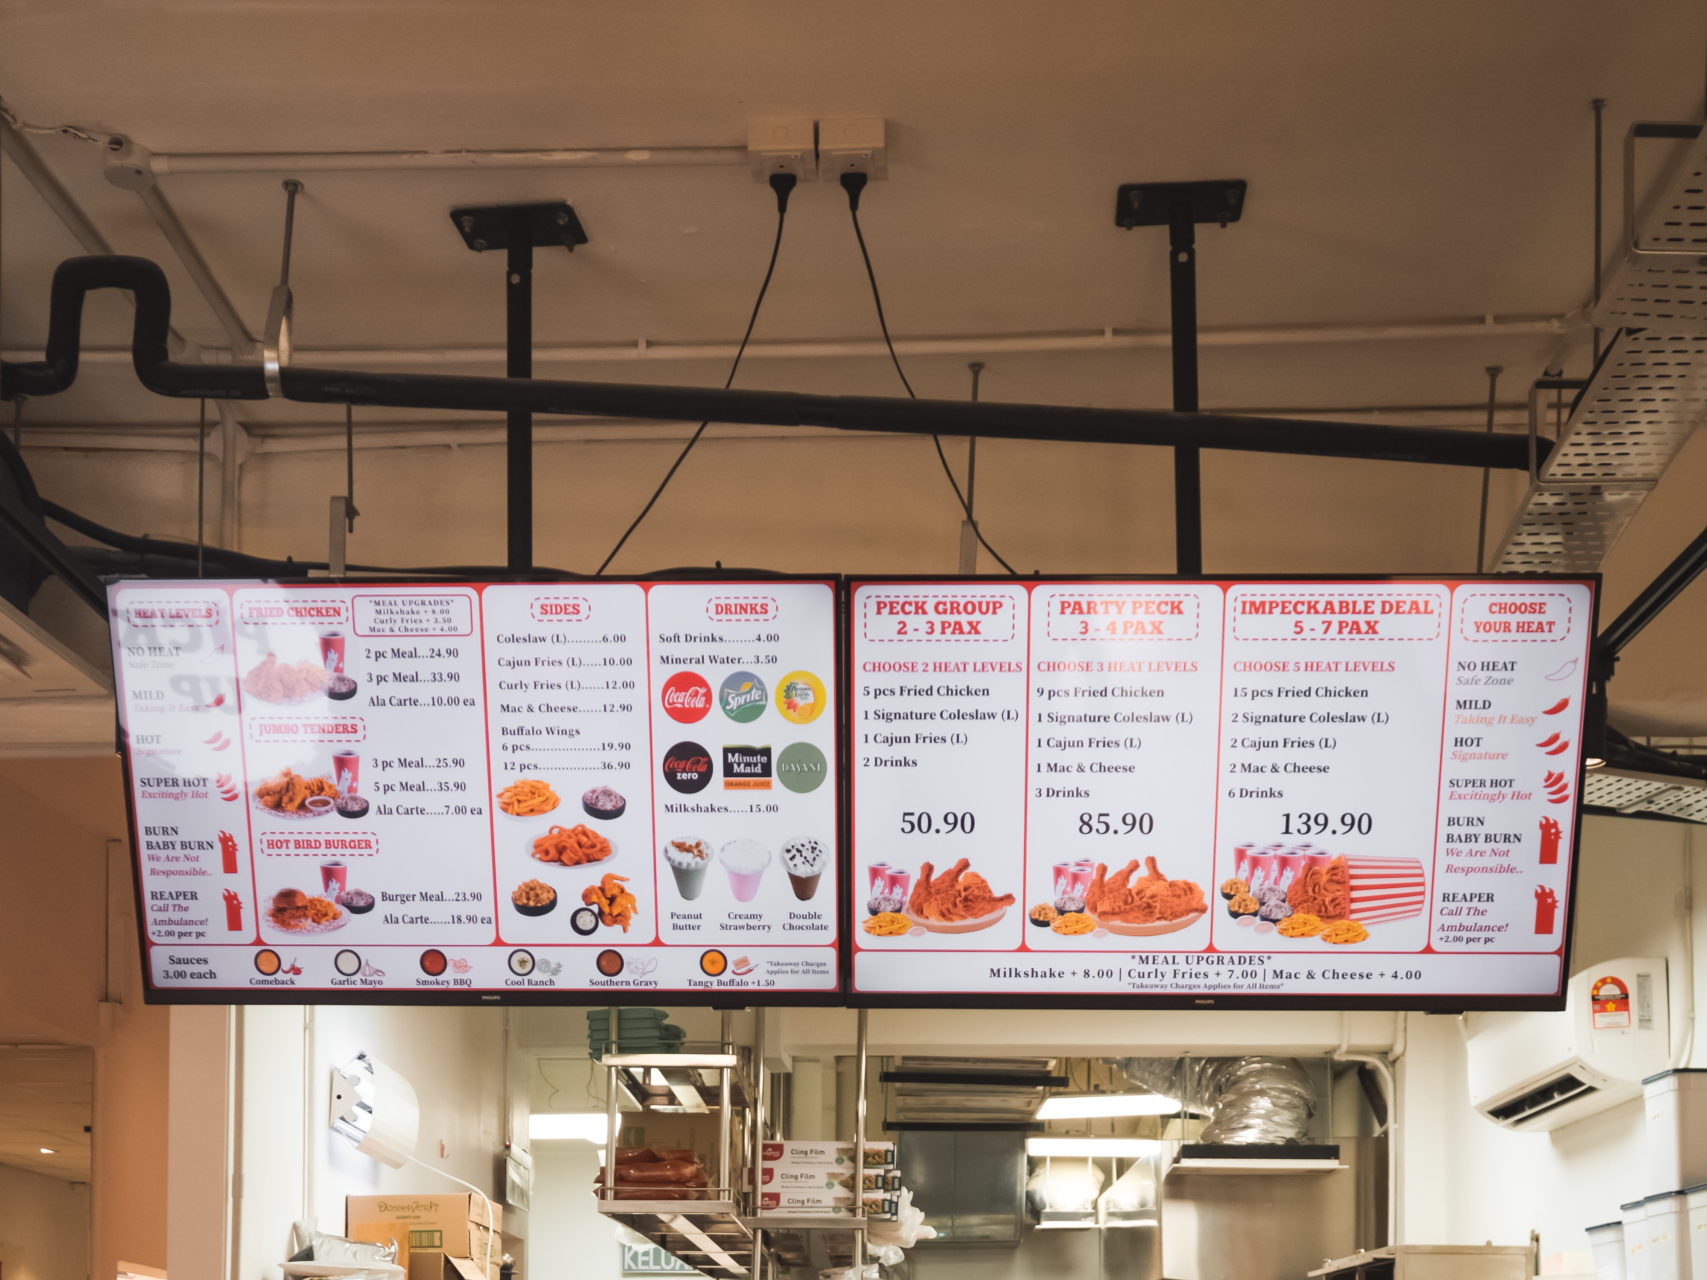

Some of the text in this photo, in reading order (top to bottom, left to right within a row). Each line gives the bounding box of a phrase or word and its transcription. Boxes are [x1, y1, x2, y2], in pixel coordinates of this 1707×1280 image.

[249, 606, 341, 618] FRIED CHICKEN
[540, 604, 580, 615] SIDES
[715, 603, 768, 615] DRINKS
[876, 601, 1003, 615] PECK GROUP
[1060, 600, 1184, 615] PARTY PECK
[1241, 600, 1433, 615] IMPECKABLE DEAL
[1489, 602, 1546, 614] CHOOSE
[897, 621, 907, 635] 2
[926, 621, 935, 635] 3
[940, 621, 981, 635] PAX
[1294, 621, 1304, 635] 5
[1322, 620, 1332, 634] 7
[1337, 620, 1379, 634] PAX
[1475, 621, 1556, 633] YOUR HEAT
[497, 634, 546, 643] Coleslaw
[659, 633, 680, 642] Soft
[365, 649, 371, 658] 2
[375, 651, 387, 662] pc
[660, 655, 704, 664] Mineral
[498, 657, 530, 669] Cajun
[535, 657, 562, 666] Fries
[863, 662, 1022, 672] CHOOSE 2 HEAT LEVELS
[1458, 661, 1517, 671] NO HEAT
[1456, 675, 1514, 685] Safe Zone
[863, 685, 989, 699] 5 pcs Fried Chicken
[1234, 686, 1368, 700] 15 pcs Fried Chicken
[369, 696, 386, 706] Ala
[463, 698, 475, 706] ea
[726, 688, 761, 710] Sprite
[501, 704, 523, 712] Mac
[527, 704, 534, 712] &
[1456, 700, 1491, 709] MILD
[1455, 714, 1537, 727] Taking It Easy
[259, 723, 358, 735] JUMBO TENDERS
[502, 726, 580, 738] Buffalo Wings
[1454, 737, 1483, 747] HOT
[728, 753, 767, 763] Minute
[1450, 750, 1508, 762] Signature
[373, 758, 378, 768] 3
[382, 760, 394, 771] pc
[864, 756, 917, 767] 2 Drinks
[734, 763, 762, 773] Maid
[140, 778, 208, 788] SUPER HOT
[901, 812, 975, 834] 50.90
[1079, 813, 1153, 834] 85.90
[1281, 813, 1372, 835] 139.90
[145, 826, 178, 836] BURN
[146, 841, 213, 850] BABY BURN
[266, 839, 372, 849] HOT BIRD BURGER
[151, 891, 198, 900] REAPER
[381, 892, 416, 904] Burger
[728, 912, 762, 922] Creamy
[720, 923, 771, 932] Strawberry
[169, 955, 208, 965] Sauces
[162, 969, 216, 979] 3.00 each
[990, 968, 1064, 978] Milkshake
[1084, 969, 1113, 978] 8.00
[1272, 970, 1300, 979] Mac
[1306, 970, 1315, 979] &
[1322, 969, 1372, 979] Cheese
[1391, 970, 1421, 979] 4.00
[250, 977, 295, 985] Comeback
[360, 978, 383, 987] Mayo
[416, 978, 472, 987] Smokey BBQ
[589, 979, 658, 988] Southern Gravy
[688, 980, 713, 988] Tangy
